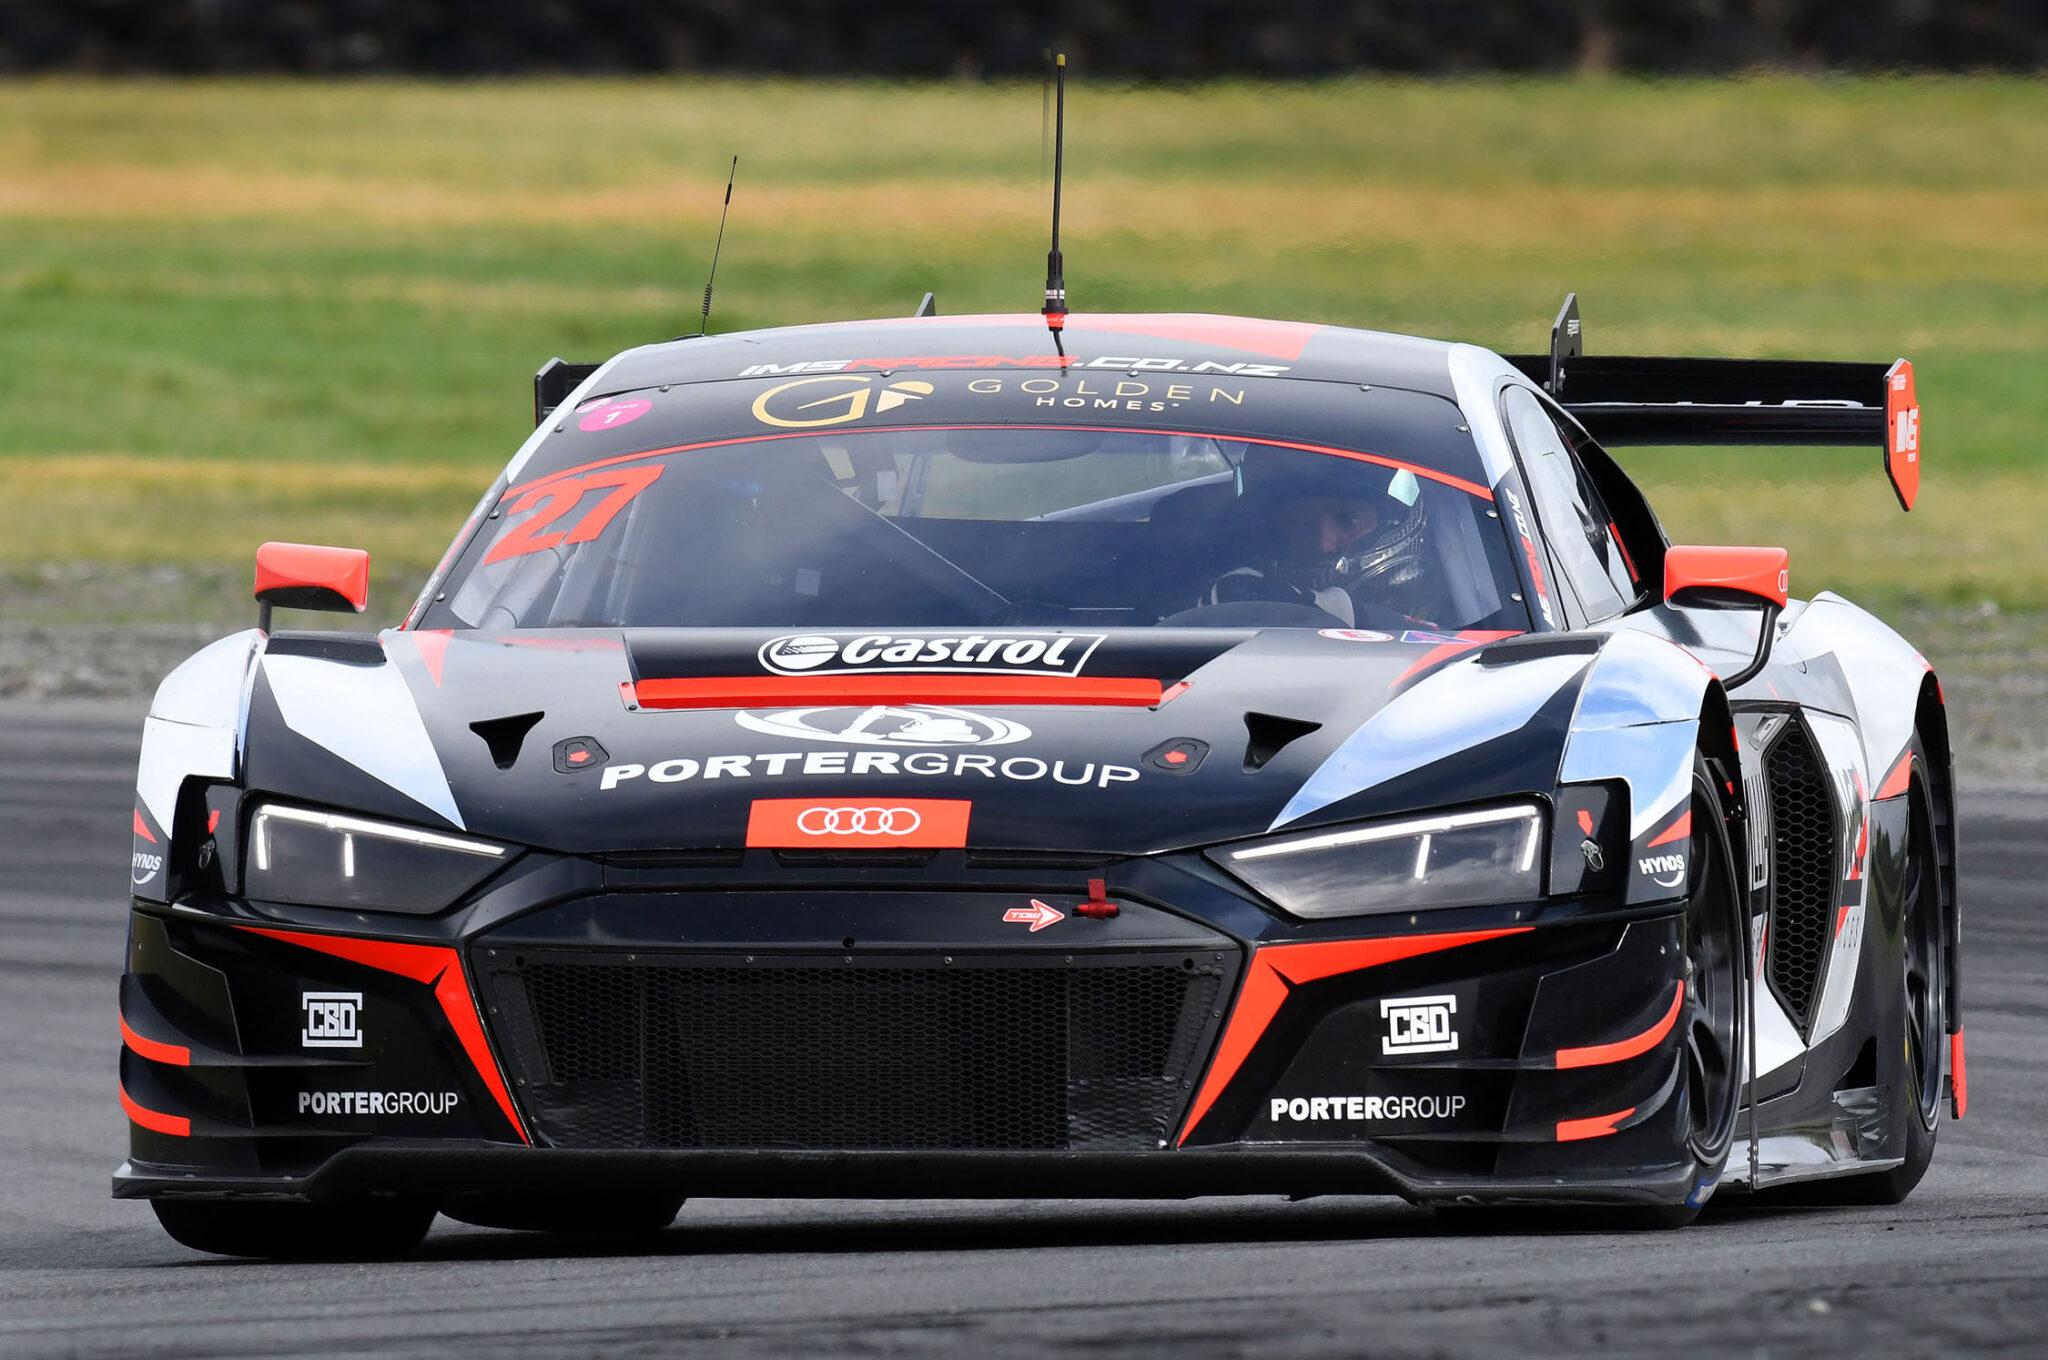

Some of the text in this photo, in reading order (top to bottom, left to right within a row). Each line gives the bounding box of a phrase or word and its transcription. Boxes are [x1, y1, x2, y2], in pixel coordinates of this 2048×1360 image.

[967, 379, 1245, 405] GOLDEN
[1035, 397, 1165, 411] HOMES
[483, 464, 666, 566] 27
[841, 635, 1074, 666] Castrol
[599, 751, 1141, 791] PORTERGROUP
[132, 853, 162, 870] HYNDS
[1639, 854, 1685, 875] HYNDS
[308, 1002, 357, 1038] CBD
[1388, 1006, 1450, 1044] CBD
[298, 1091, 459, 1114] PORTERGROUP
[1270, 1095, 1467, 1122] PORTERGROUP
